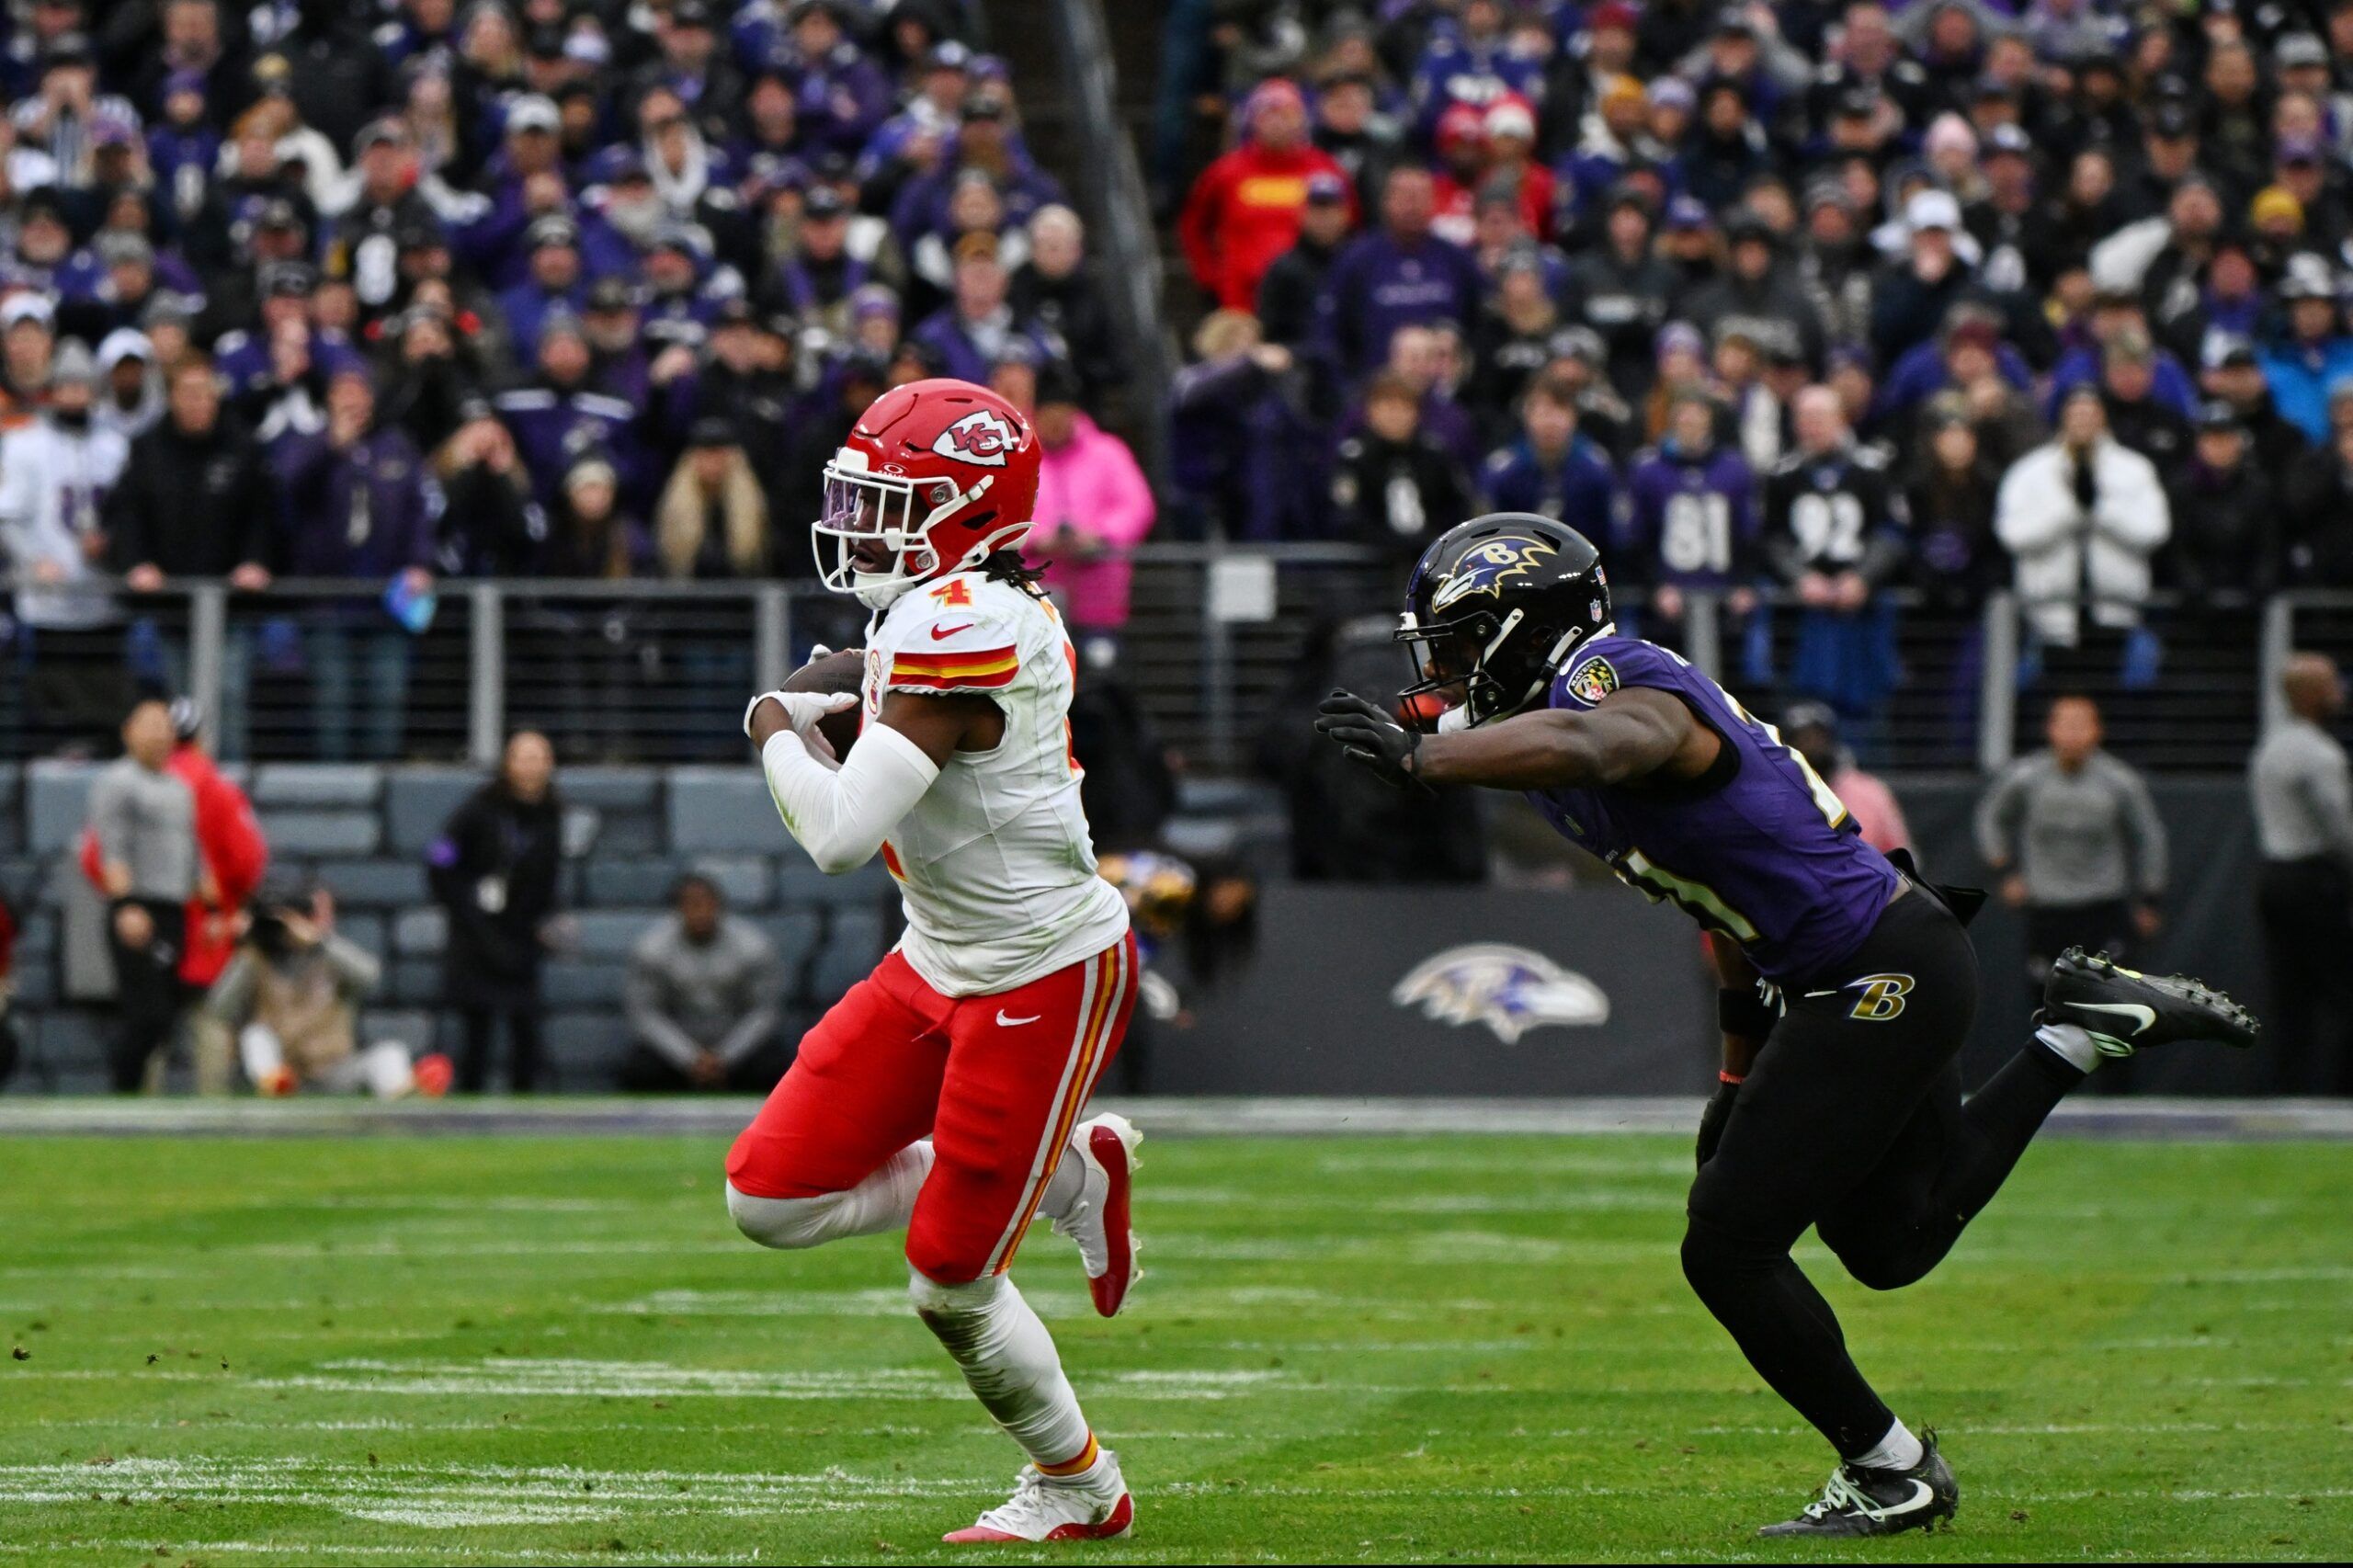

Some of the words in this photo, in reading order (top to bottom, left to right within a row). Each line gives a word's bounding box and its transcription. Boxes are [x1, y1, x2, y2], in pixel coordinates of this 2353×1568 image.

[949, 422, 1006, 458] KC
[1662, 493, 1732, 574] 81
[1789, 494, 1865, 562] 92
[1466, 542, 1518, 564] B
[928, 578, 972, 608] 4
[1844, 972, 1915, 1021] B
